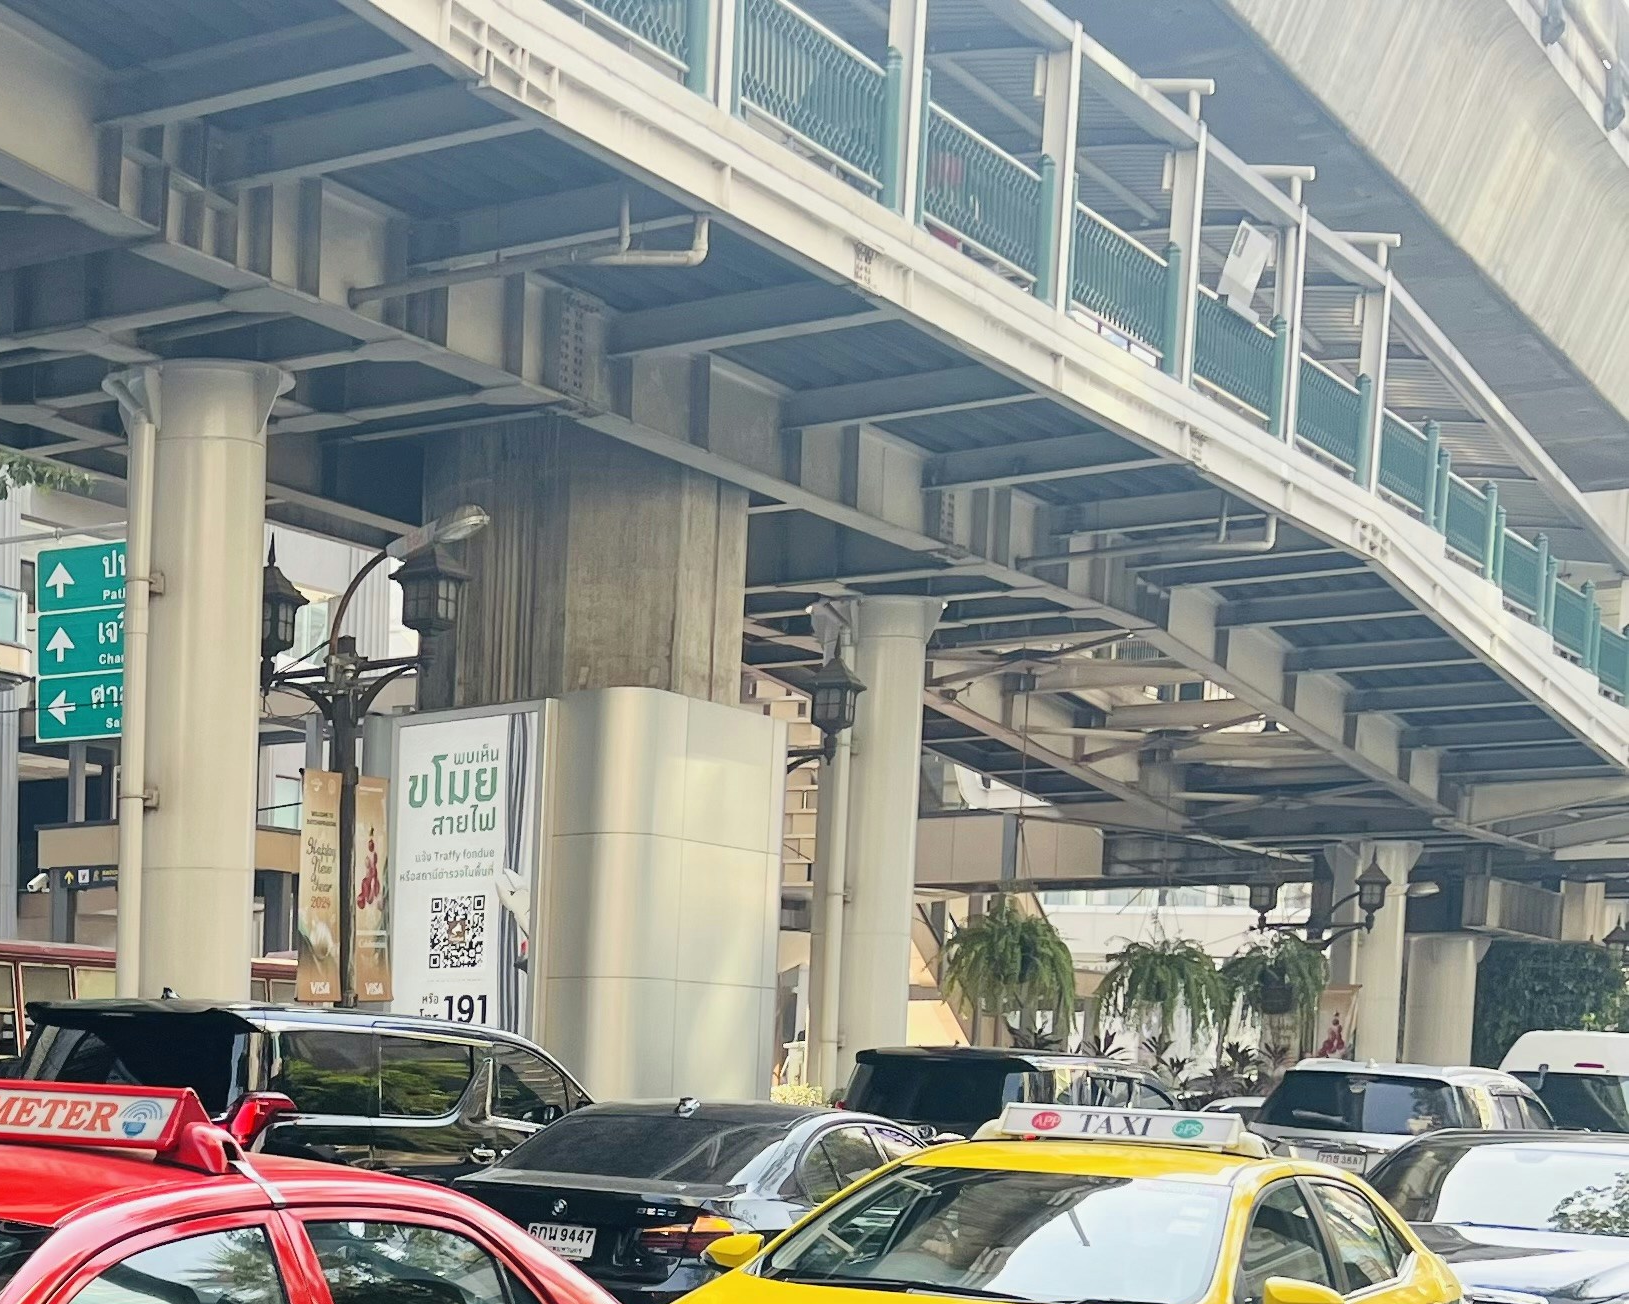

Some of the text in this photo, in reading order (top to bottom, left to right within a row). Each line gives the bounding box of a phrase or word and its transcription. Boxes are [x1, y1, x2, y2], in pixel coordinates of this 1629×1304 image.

[408, 753, 498, 808] ขโมย
[431, 804, 496, 836] สายไฟ
[306, 836, 337, 863] Happy
[434, 850, 461, 862] Traffy
[463, 847, 495, 860] fondue
[311, 856, 333, 876] New
[309, 982, 331, 995] VISA
[443, 994, 487, 1025] 191
[1034, 1116, 1060, 1127] APP
[1079, 1113, 1152, 1137] TAXI
[1173, 1123, 1202, 1134] GPS
[560, 1228, 594, 1244] 9447
